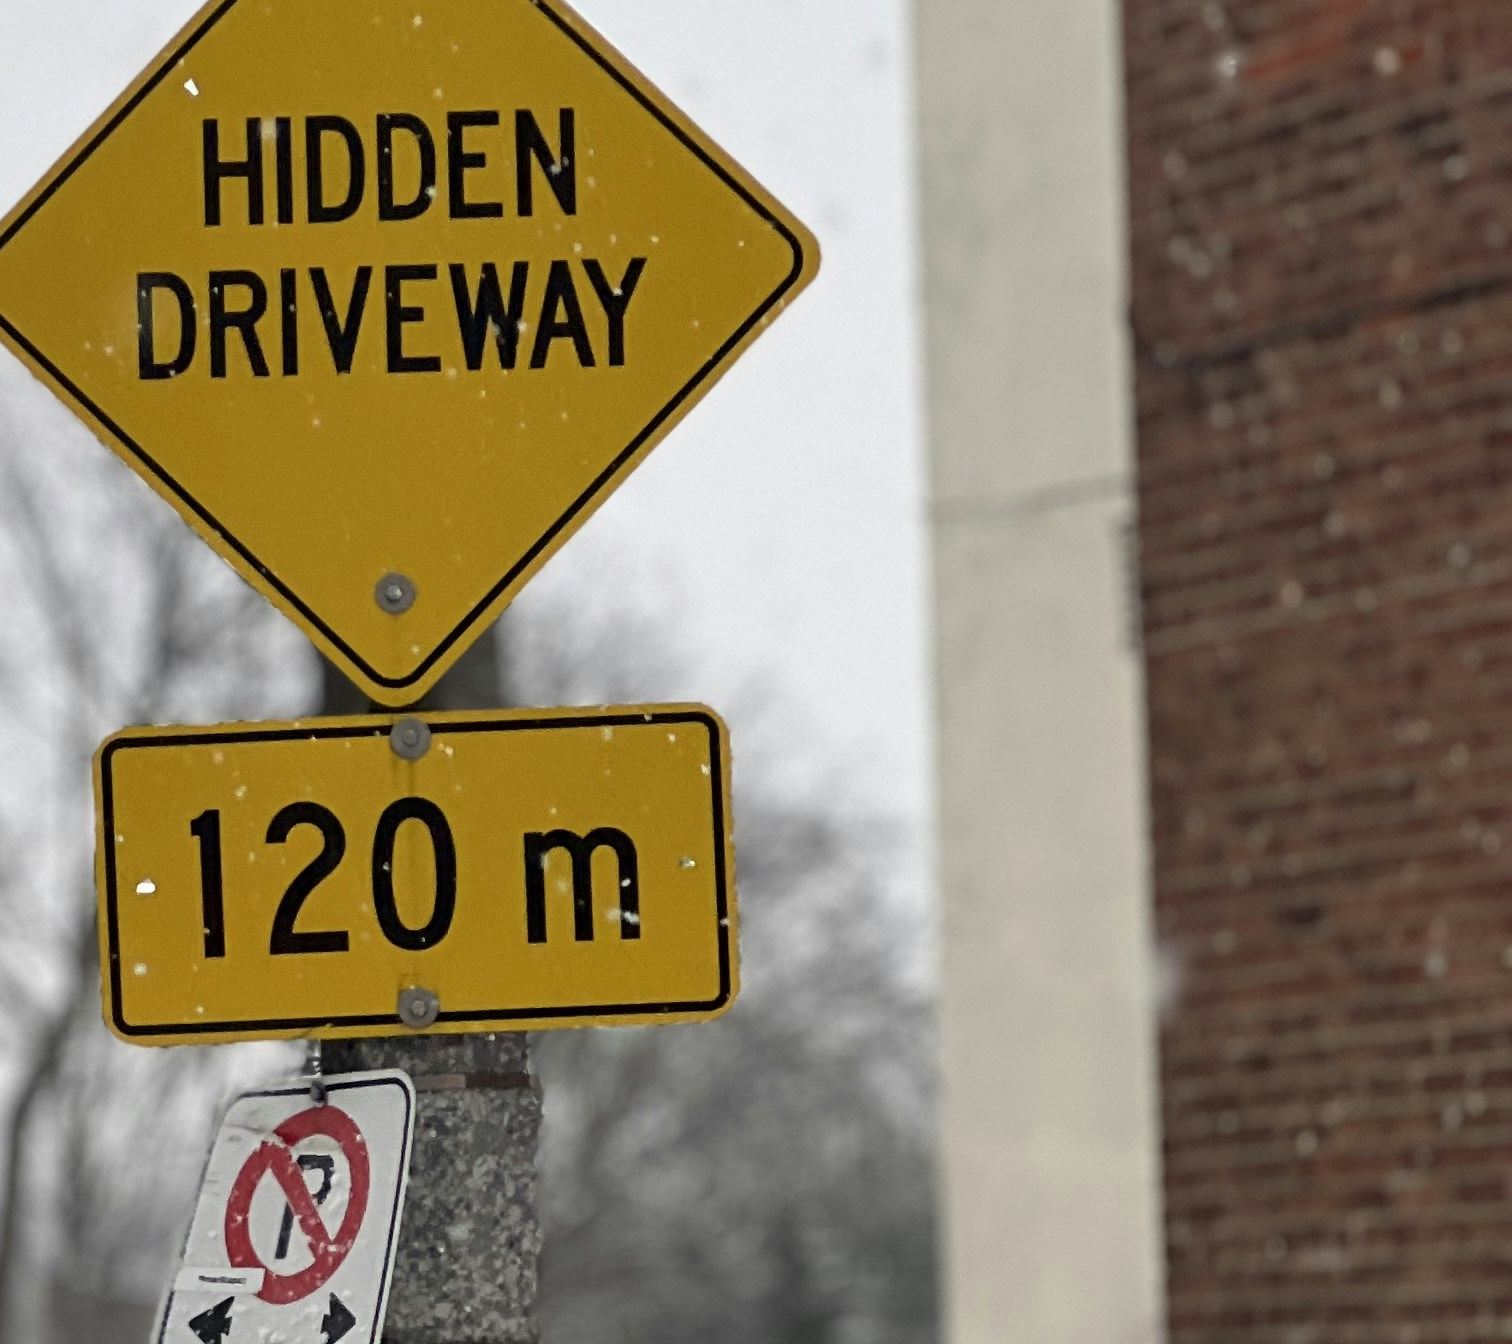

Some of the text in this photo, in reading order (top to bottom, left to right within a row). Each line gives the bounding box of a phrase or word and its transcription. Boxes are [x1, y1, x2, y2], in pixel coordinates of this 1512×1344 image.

[202, 107, 577, 227] HIDDEN
[136, 257, 647, 381] DRIVEWAY
[190, 796, 641, 958] 120 m
